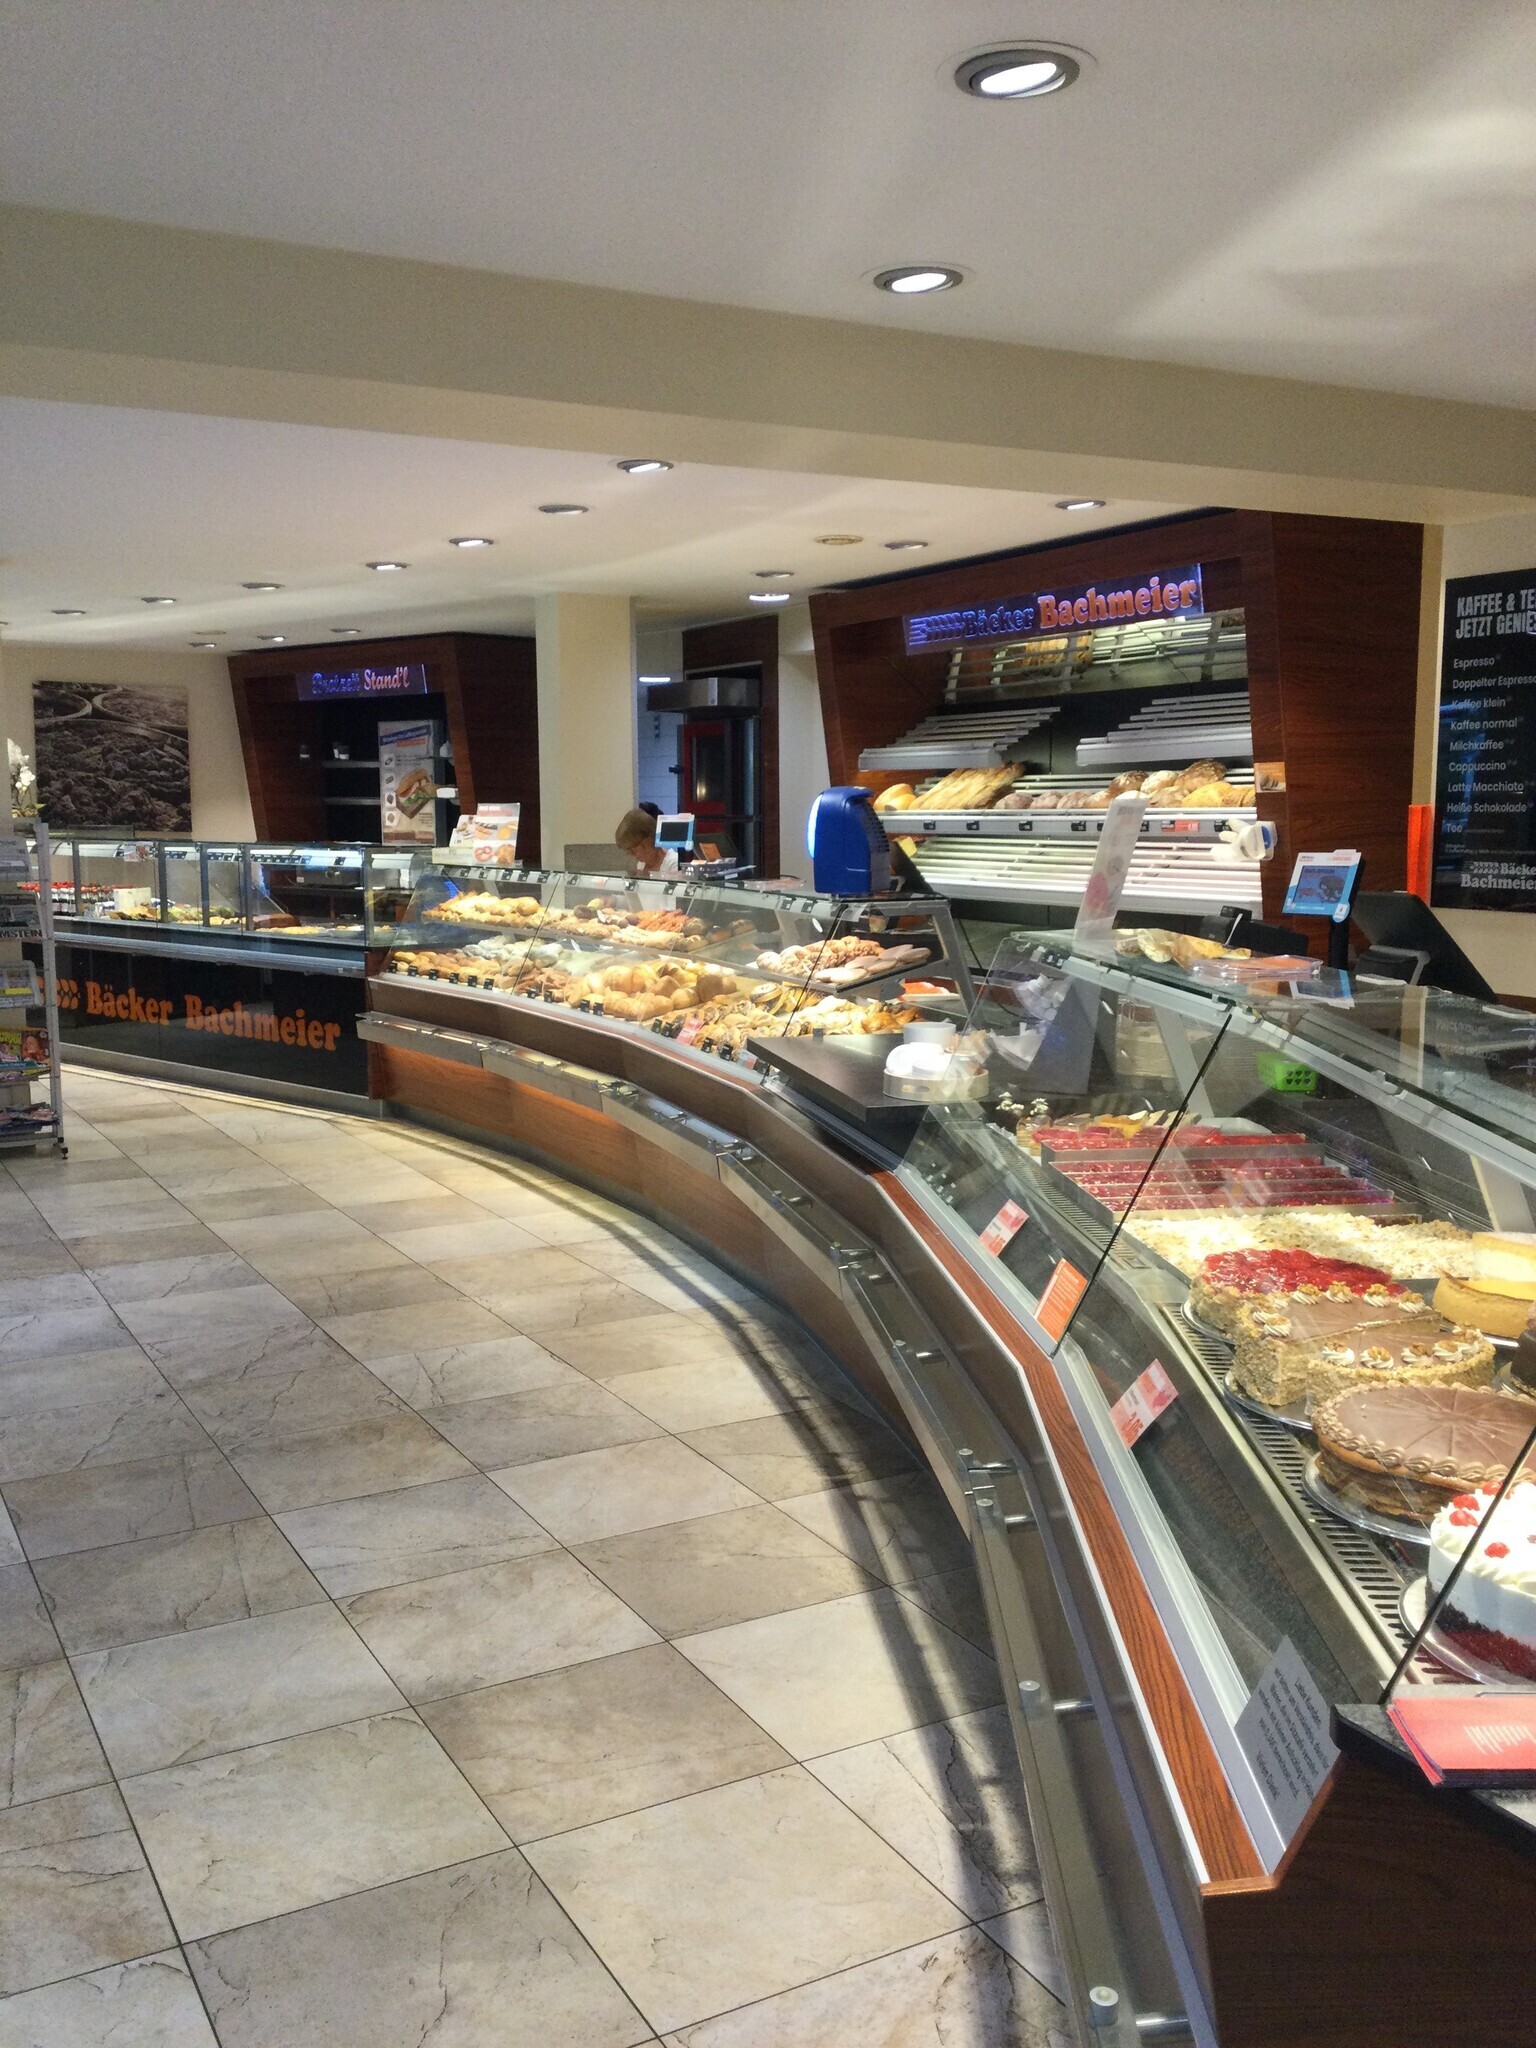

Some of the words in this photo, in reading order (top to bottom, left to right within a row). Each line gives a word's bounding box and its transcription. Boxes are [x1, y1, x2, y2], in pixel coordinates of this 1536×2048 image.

[1037, 576, 1197, 630] Bachmeier
[1456, 592, 1503, 617] KAFFEE
[1506, 593, 1516, 611] &
[1519, 588, 1536, 610] TE
[1455, 615, 1493, 639] JETZT
[1453, 657, 1495, 671] Espresso
[363, 666, 411, 691] Stand'l
[1452, 677, 1497, 692] Doppelter
[1452, 698, 1482, 710] Kaffee
[1483, 696, 1506, 708] klein
[1450, 720, 1481, 731] Kaffee
[1482, 717, 1518, 729] normal
[1449, 739, 1504, 752] Milchkaffee
[1448, 760, 1507, 774] Cappuccino
[1447, 782, 1472, 793] Latte
[1472, 780, 1524, 792] Macchiato
[1446, 802, 1473, 813] Heiße
[1474, 802, 1527, 813] Schokolade
[1446, 823, 1463, 833] Tee
[85, 980, 174, 1026] Bäcker
[184, 993, 342, 1051] Bachmeier
